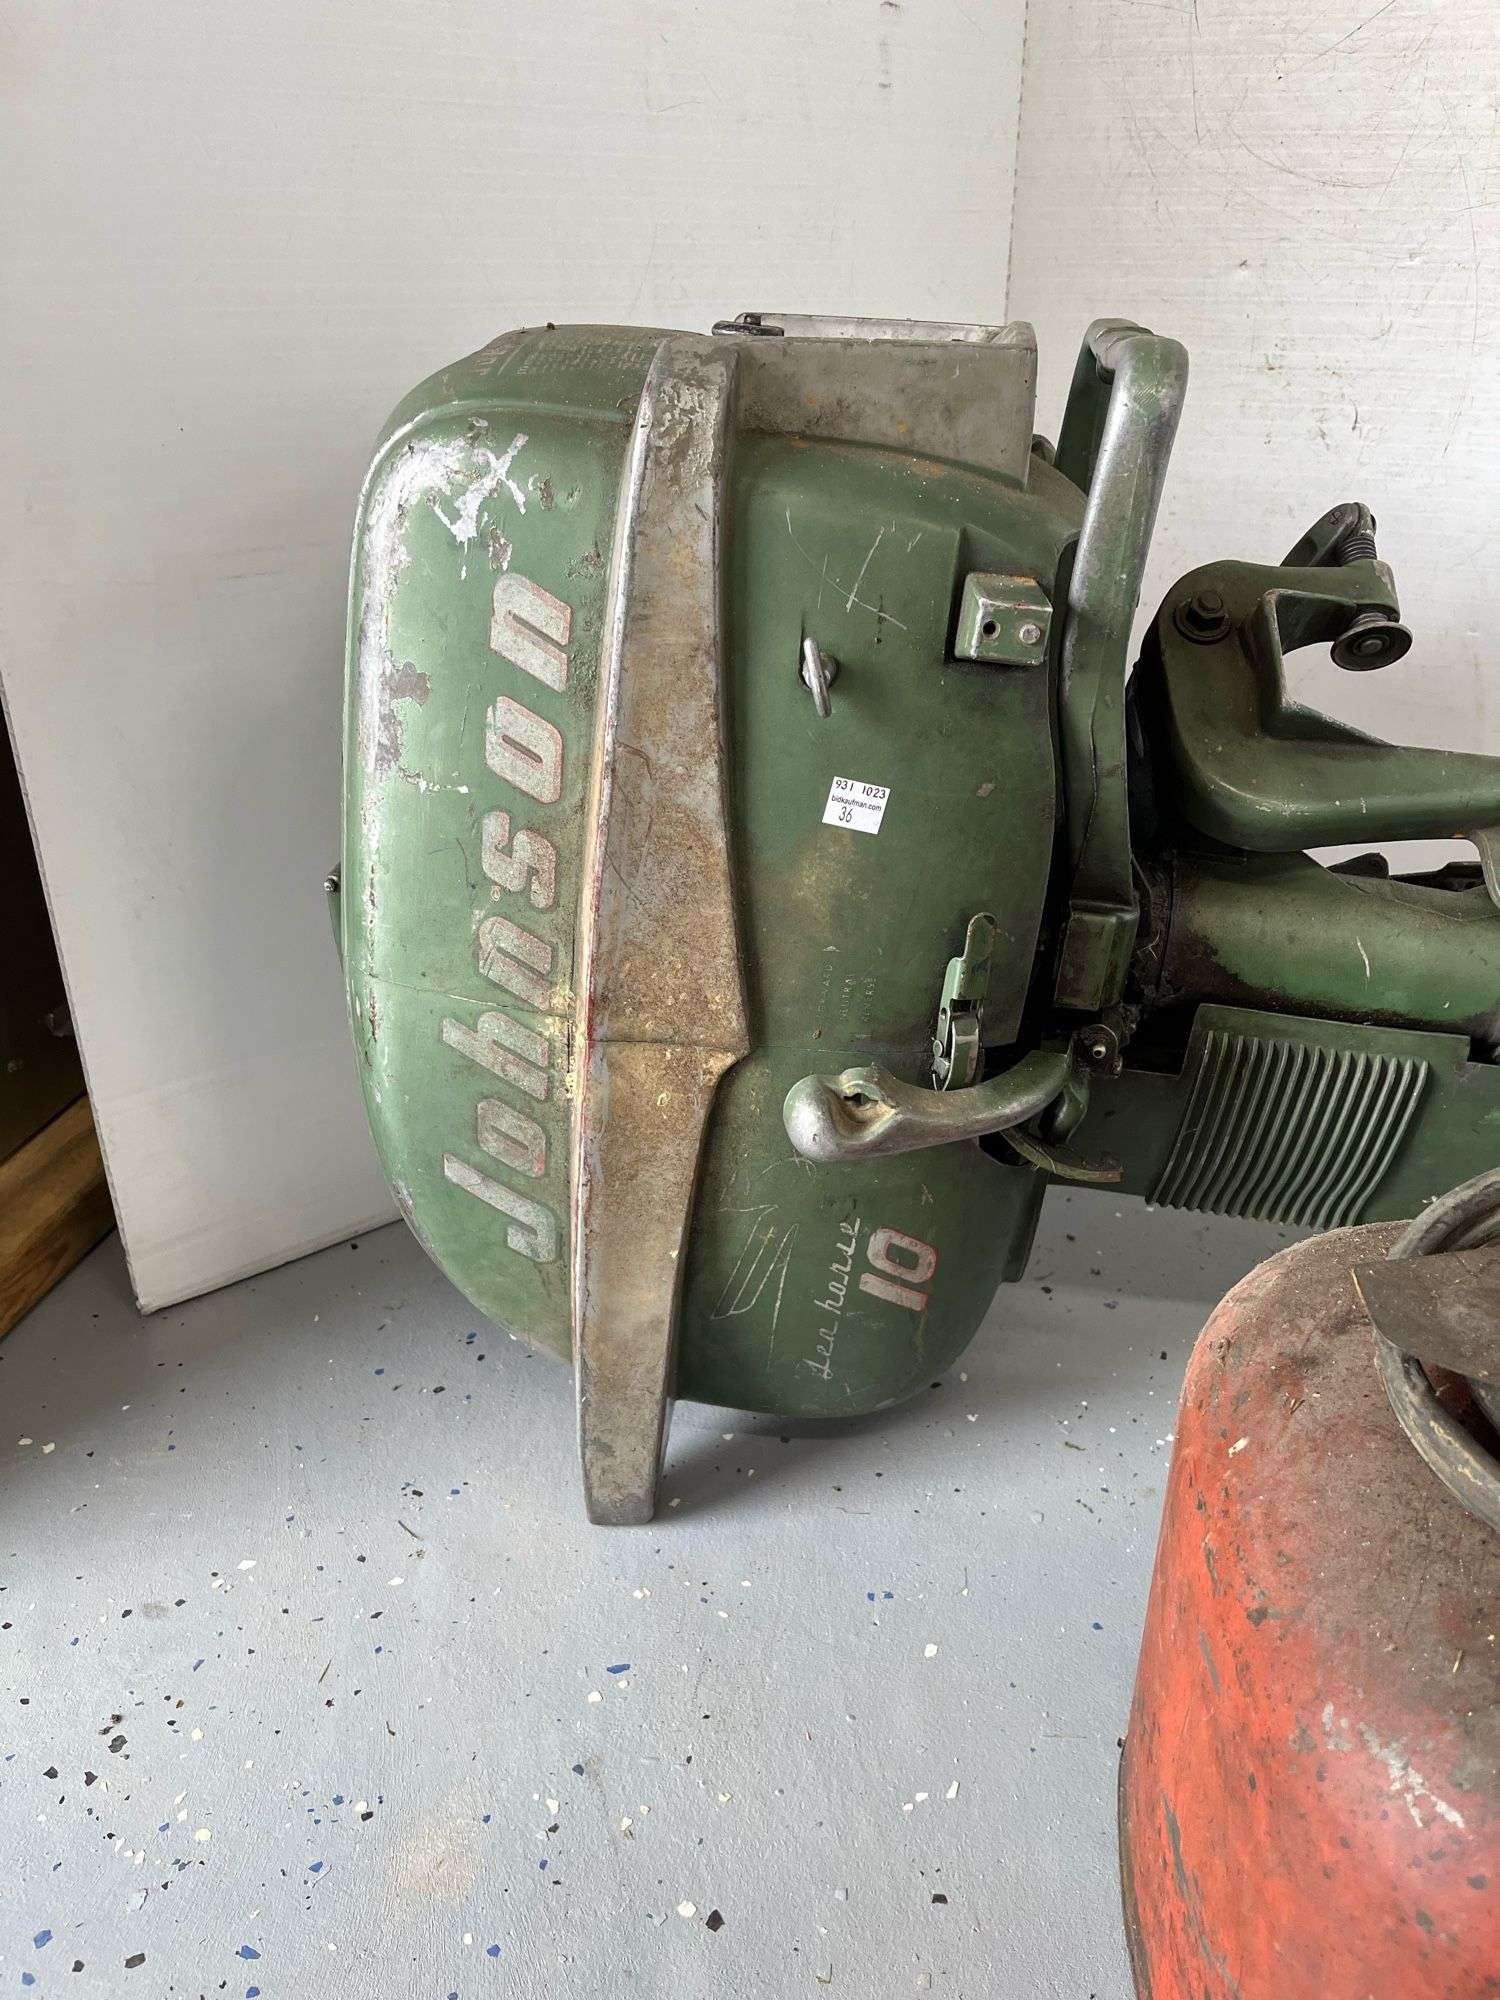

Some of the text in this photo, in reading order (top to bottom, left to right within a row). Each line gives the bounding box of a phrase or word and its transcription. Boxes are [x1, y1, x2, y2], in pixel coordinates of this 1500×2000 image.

[835, 779, 886, 799] 931 1023
[831, 795, 882, 811] bidkaufman.com
[838, 806, 853, 823] 36
[440, 572, 572, 1264] Johnson
[858, 1226, 939, 1312] 10
